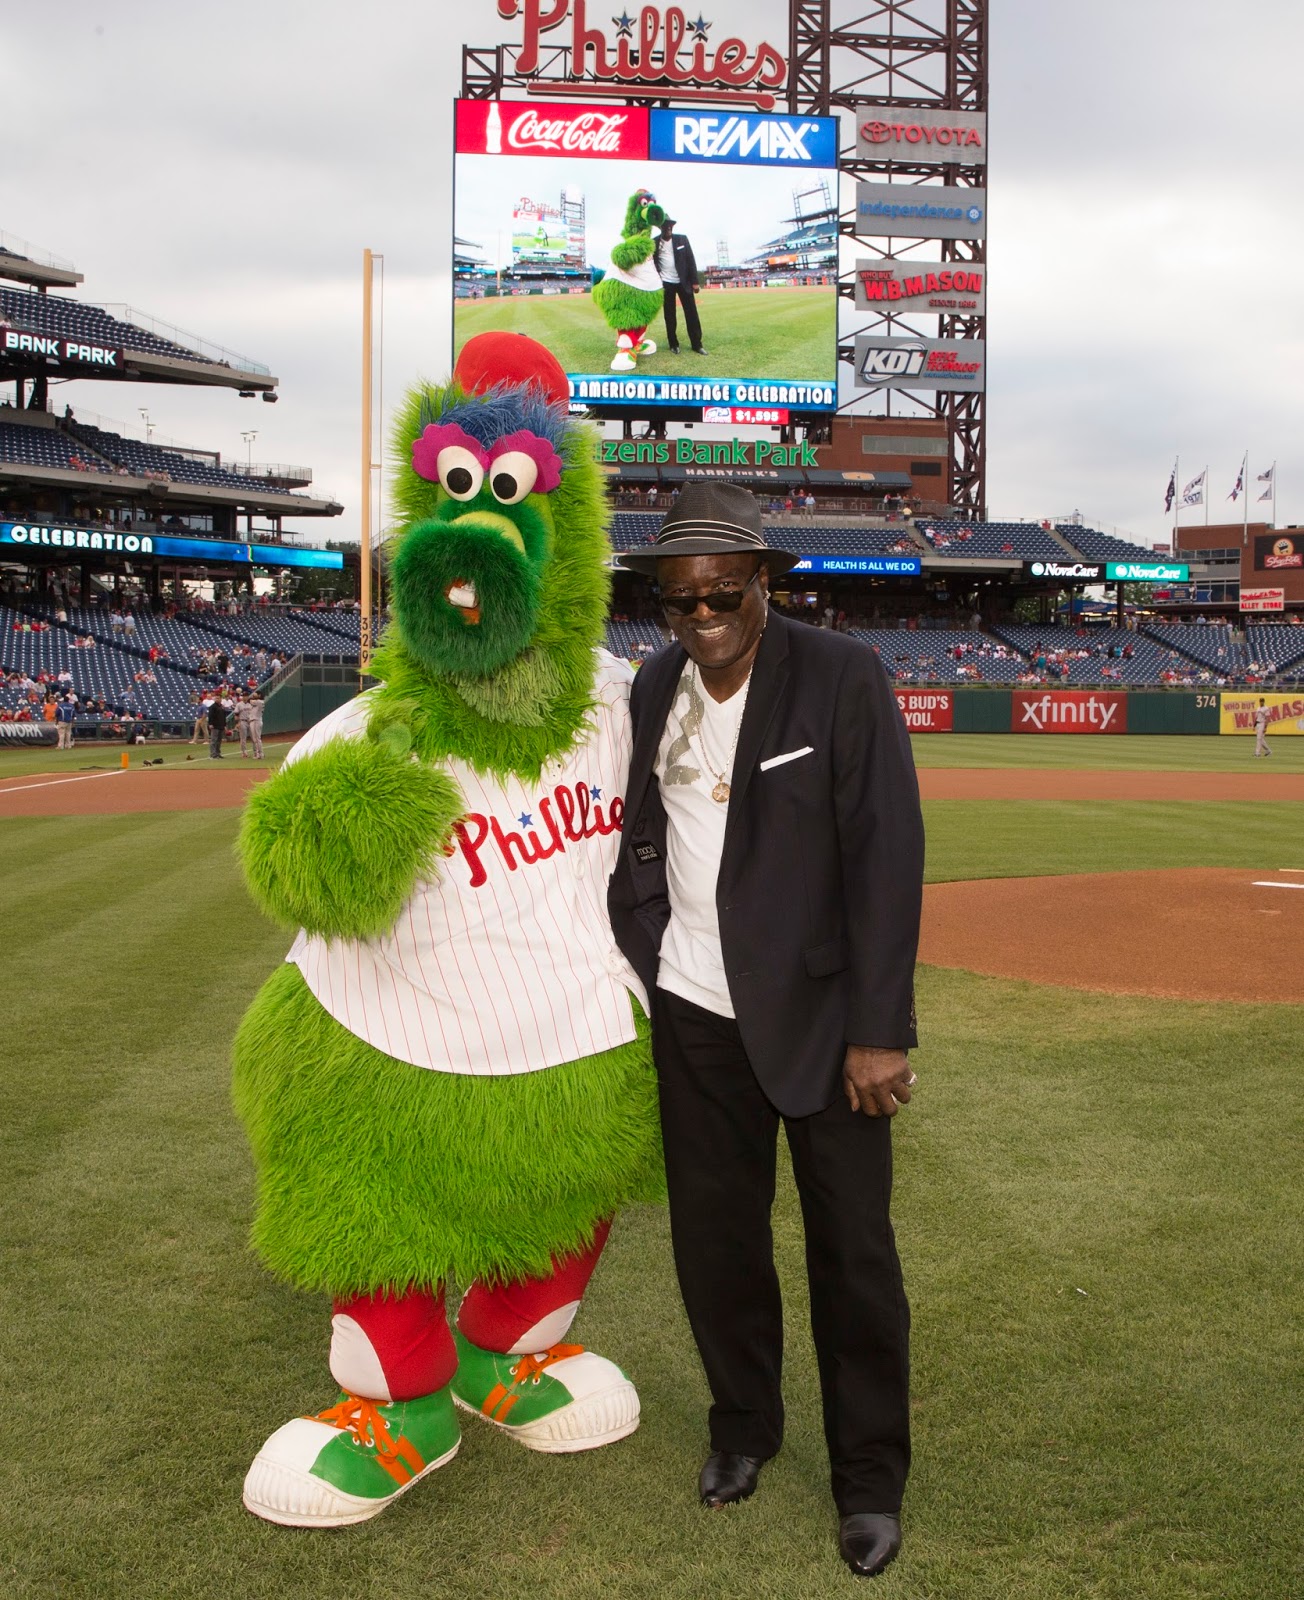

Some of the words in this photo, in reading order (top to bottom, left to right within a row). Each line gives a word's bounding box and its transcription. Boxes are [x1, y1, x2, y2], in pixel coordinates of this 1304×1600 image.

[497, 0, 789, 88] Phillies
[508, 110, 628, 152] Coca-Cola
[675, 117, 812, 160] RE/MAX
[892, 124, 981, 146] TOYOTA
[860, 201, 963, 219] Independence
[929, 299, 956, 308] SINCE
[5, 331, 59, 356] BANK
[66, 342, 116, 366] PARK
[579, 381, 656, 399] AMERICAN
[661, 383, 730, 402] HERITAGE
[736, 385, 833, 404] CELEBRATION
[735, 409, 780, 423] $1,595
[676, 438, 749, 465] Bank
[755, 439, 819, 467] Park
[685, 468, 734, 476] HARRY
[755, 470, 779, 478] K'S
[10, 525, 153, 553] CELEBRATION
[823, 560, 858, 570] HEALTH
[858, 561, 868, 570] IS
[868, 561, 885, 571] ALL
[885, 562, 900, 571] WE
[900, 562, 916, 571] DO
[1043, 562, 1099, 577] NovaCare
[1127, 564, 1181, 579] NovaCare
[1241, 601, 1260, 609] ALLEY
[1262, 601, 1283, 609] STORE
[908, 695, 949, 710] BUD'S
[1195, 695, 1217, 708] 374
[1223, 703, 1240, 711] WHO
[1241, 702, 1256, 710] BUT
[904, 712, 935, 726] YOU.
[1021, 695, 1118, 729] xfinity
[443, 781, 625, 888] Phillie
